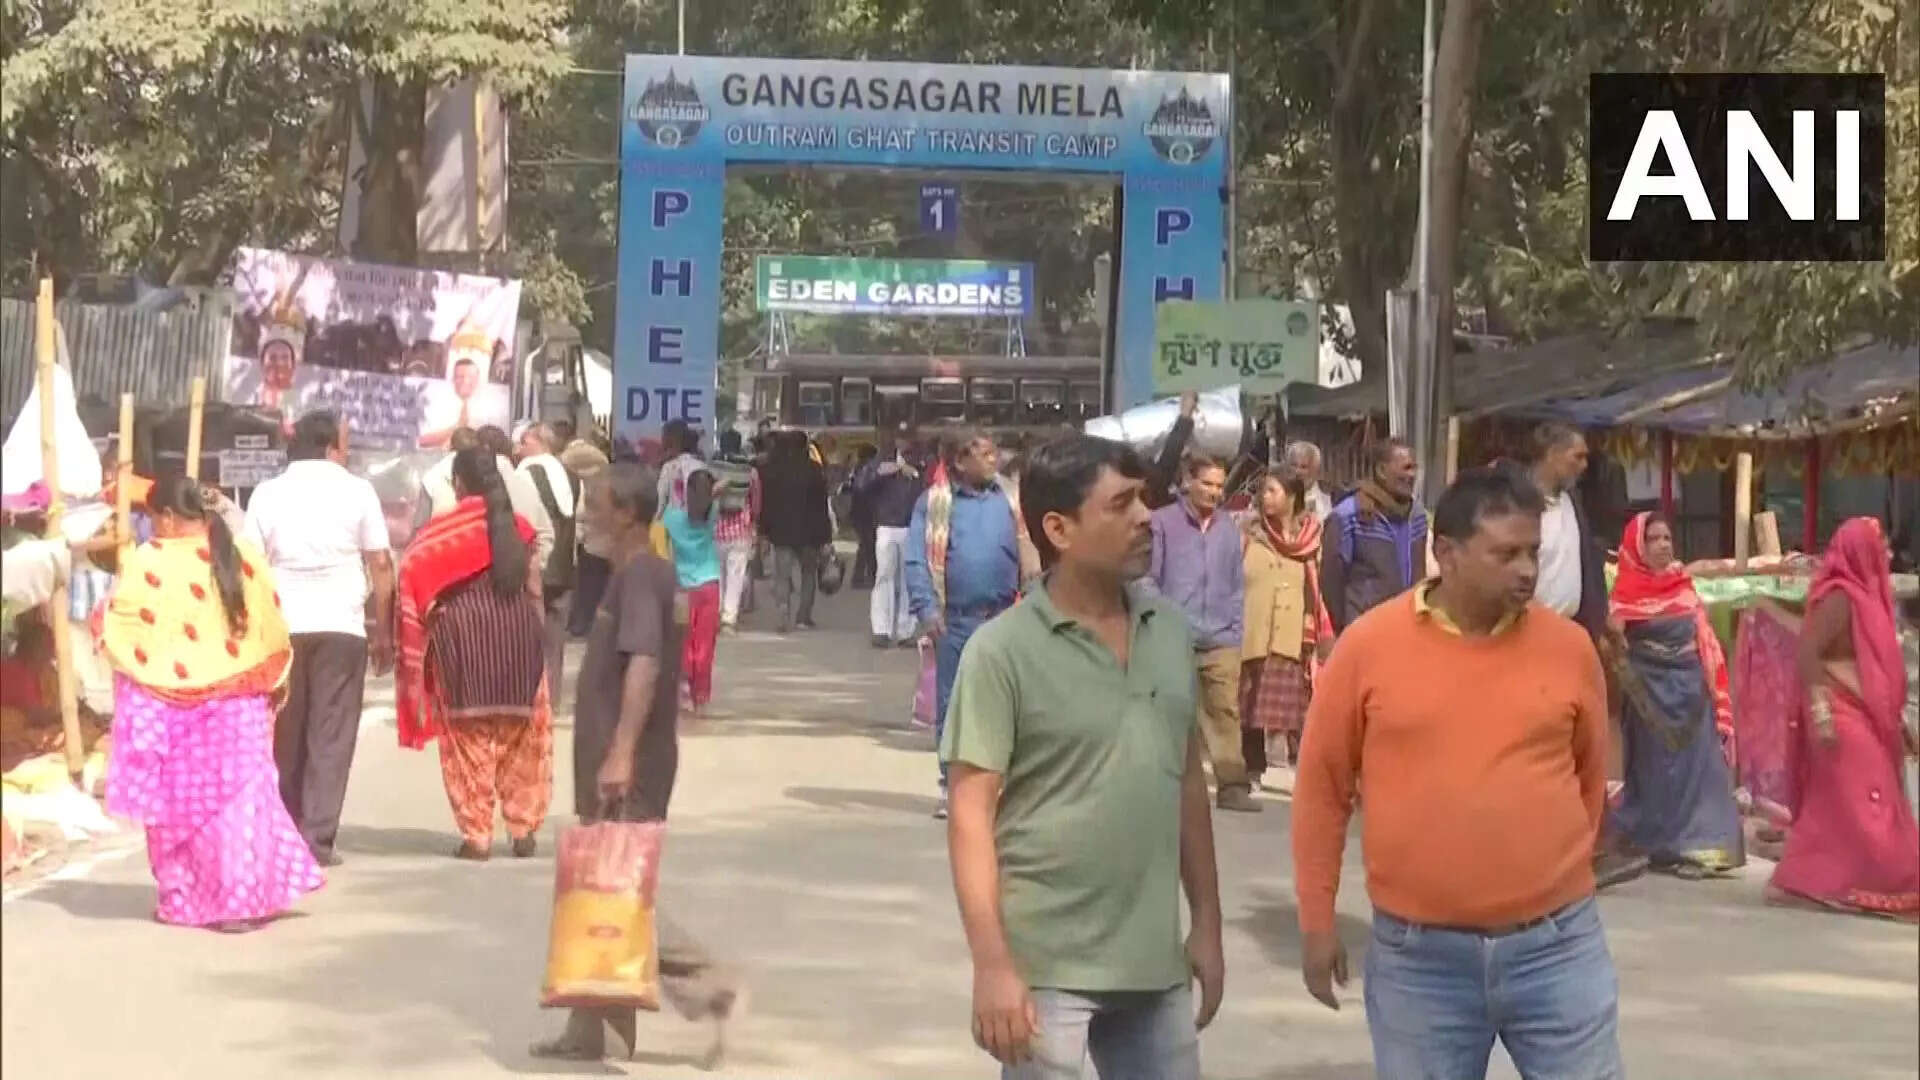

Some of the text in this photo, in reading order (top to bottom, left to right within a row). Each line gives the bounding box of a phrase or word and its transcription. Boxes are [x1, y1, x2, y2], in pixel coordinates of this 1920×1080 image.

[722, 73, 1124, 118] GANGASAGAR MELA
[726, 124, 1119, 158] OUTRAM GHAT TRANSIT CAMP
[930, 199, 943, 231] 1
[768, 278, 1023, 306] EDEN GARDENS
[626, 387, 703, 424] DTE
